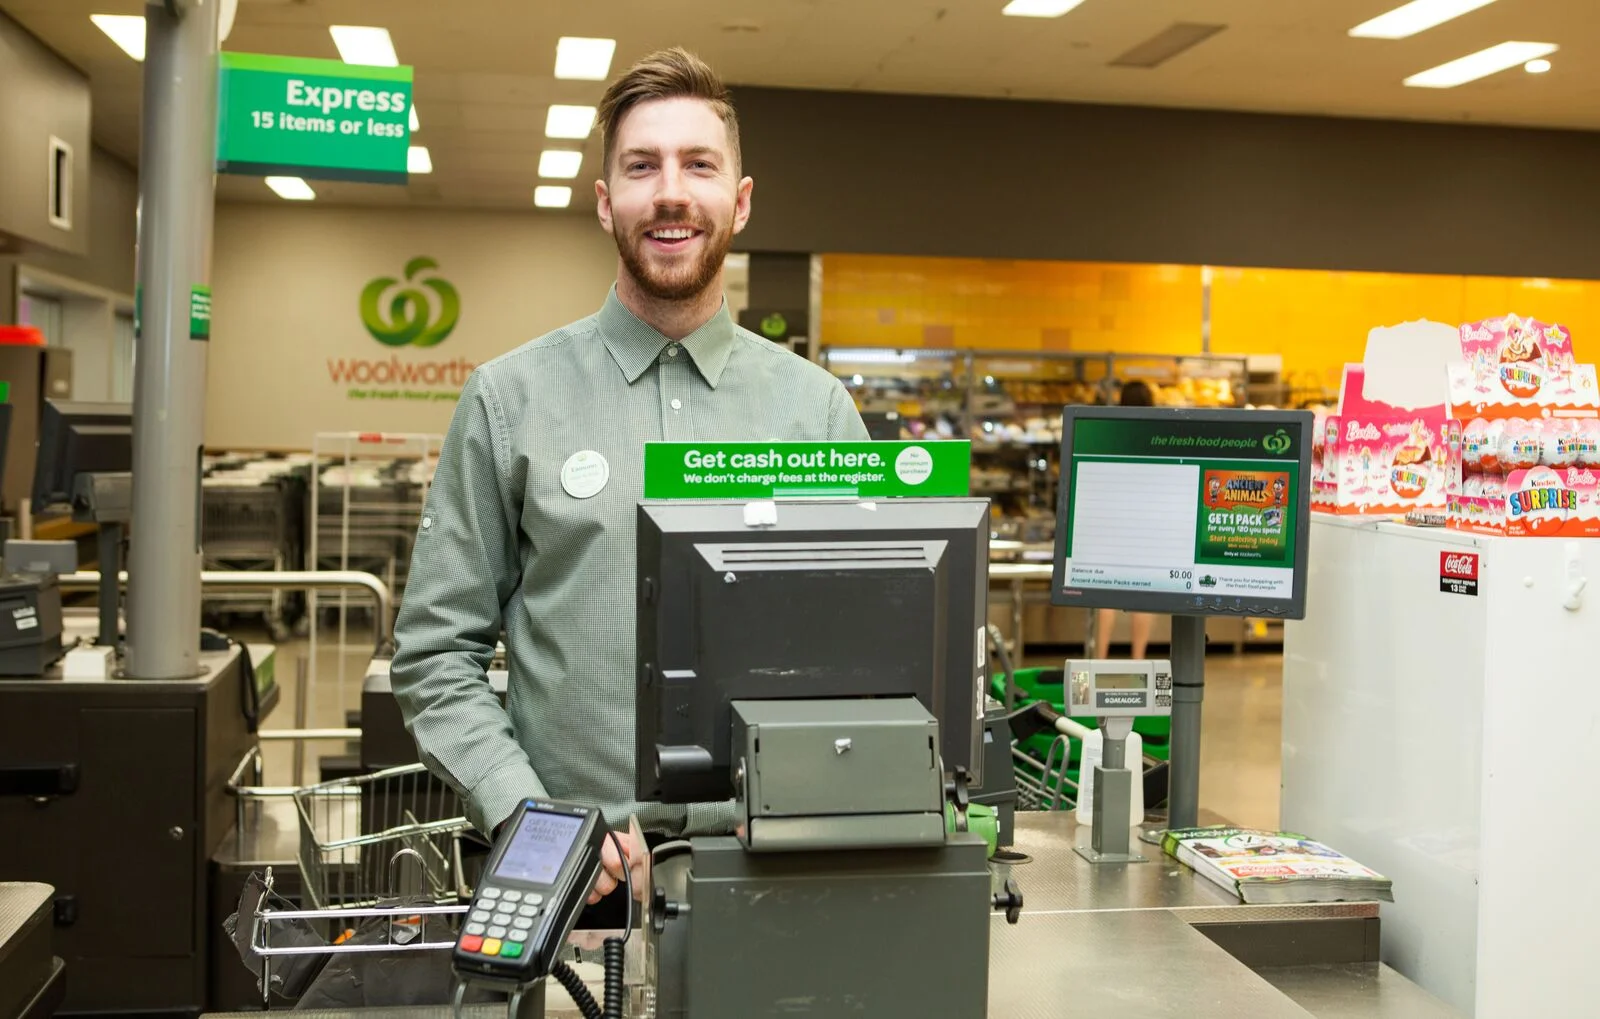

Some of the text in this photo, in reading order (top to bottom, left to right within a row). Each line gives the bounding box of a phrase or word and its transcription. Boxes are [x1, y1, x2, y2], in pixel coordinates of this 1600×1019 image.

[286, 79, 405, 114] Express
[251, 110, 404, 138] 15 items or less
[327, 353, 474, 387] Woolworth
[1500, 366, 1541, 388] SURPRISE
[1345, 420, 1381, 442] Barbie
[1150, 436, 1257, 449] the fresh food people
[684, 448, 886, 468] Get cash out here.
[683, 471, 886, 486] We don't charge fees at the register.
[1391, 468, 1427, 489] SURPRISE
[1567, 466, 1596, 486] Barbie
[1225, 479, 1268, 491] ANCIENT
[1531, 480, 1557, 488] Kinder
[1224, 489, 1268, 503] ANIMALS
[1509, 488, 1577, 516] SURPRISE
[1208, 512, 1262, 526] GET 1 PACK
[1207, 524, 1217, 532] for
[1218, 526, 1235, 535] every
[1250, 527, 1261, 535] you
[1262, 526, 1281, 535] spend
[1228, 535, 1257, 544] collecting
[1259, 536, 1279, 546] today
[1169, 569, 1192, 580] $0.00
[1114, 579, 1130, 587] Packs
[1186, 580, 1192, 590] 0
[1451, 584, 1458, 593] 13
